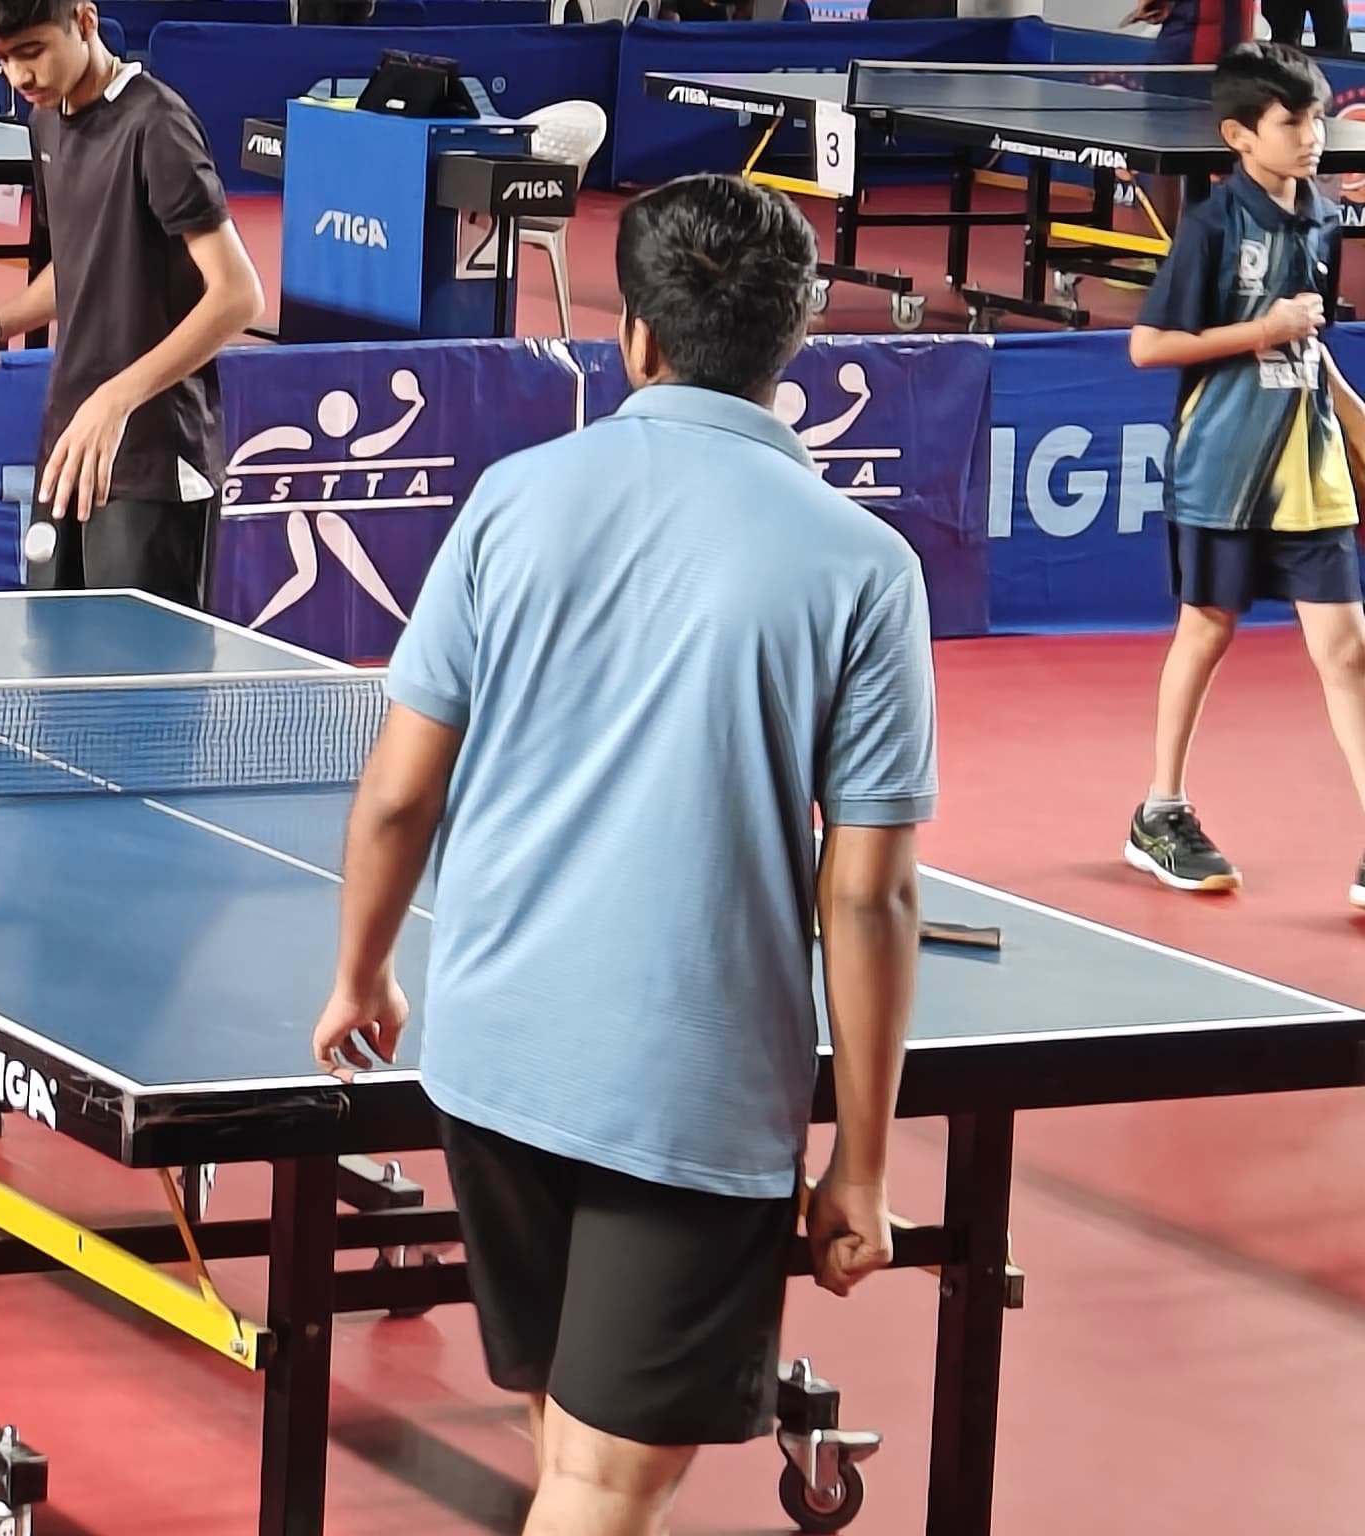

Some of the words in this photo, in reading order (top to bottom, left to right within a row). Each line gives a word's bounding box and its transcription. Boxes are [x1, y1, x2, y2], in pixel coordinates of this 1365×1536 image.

[826, 132, 840, 167] 3
[502, 180, 564, 200] STIGA
[315, 210, 389, 250] STIGA
